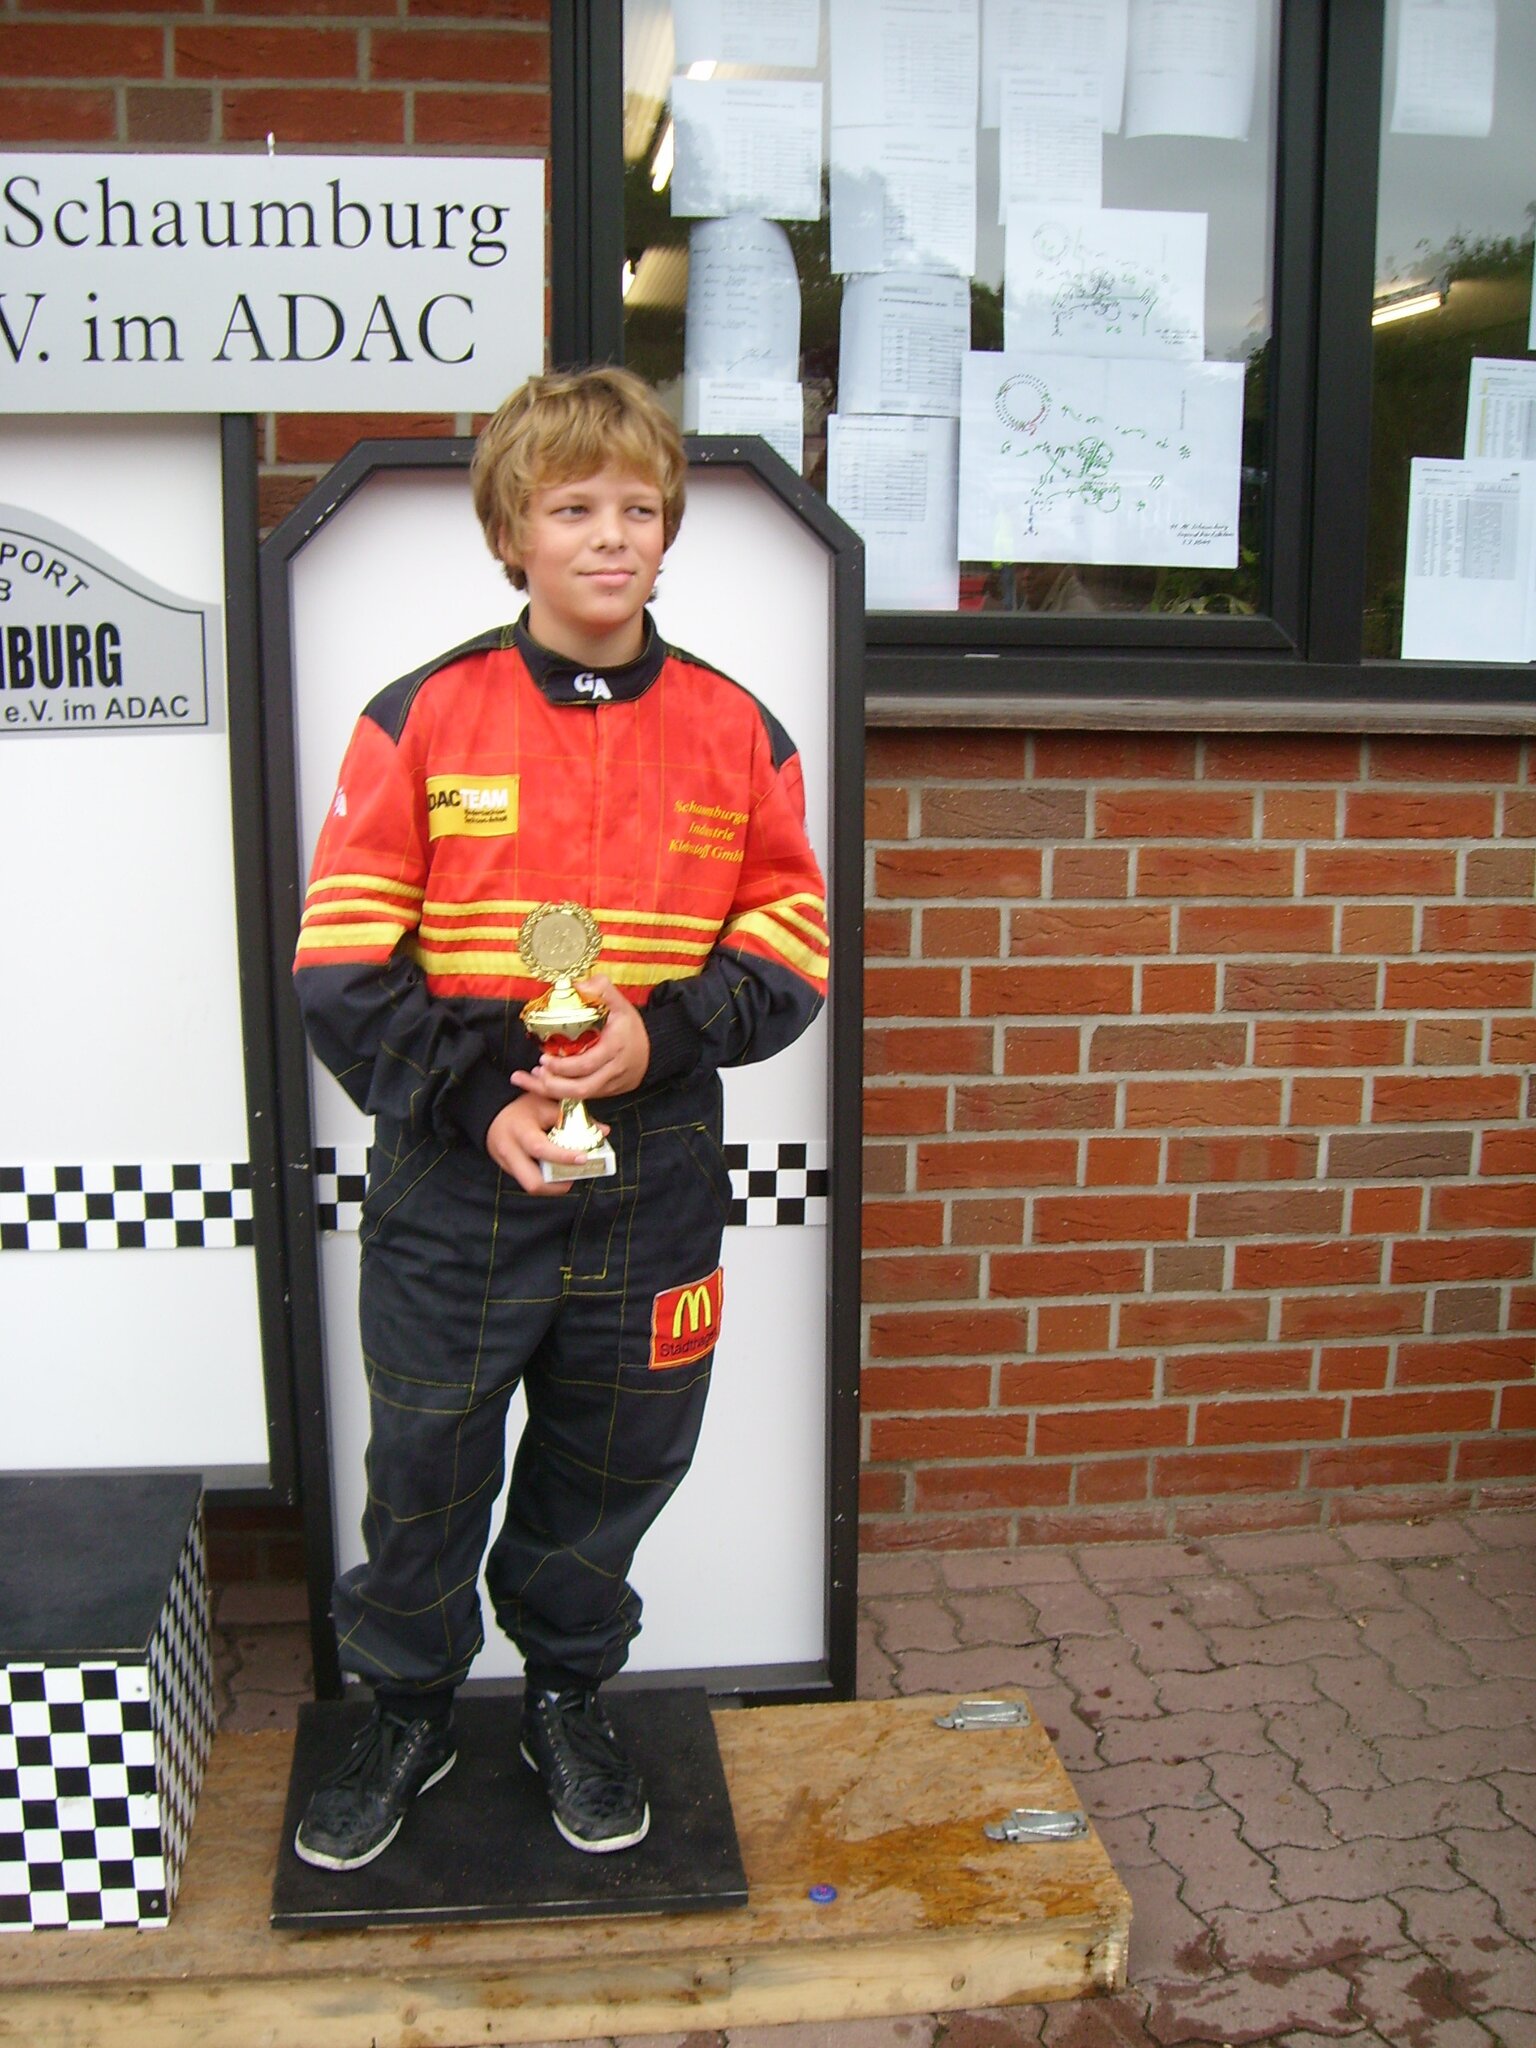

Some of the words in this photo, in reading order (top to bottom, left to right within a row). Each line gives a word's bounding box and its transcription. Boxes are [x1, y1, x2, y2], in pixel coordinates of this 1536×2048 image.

[3, 175, 511, 268] Schaumburg
[82, 291, 185, 363] im
[212, 292, 476, 364] ADAC
[0, 621, 123, 690] BURG
[5, 700, 53, 723] e.V.
[63, 699, 96, 722] im
[105, 694, 190, 720] ADAC
